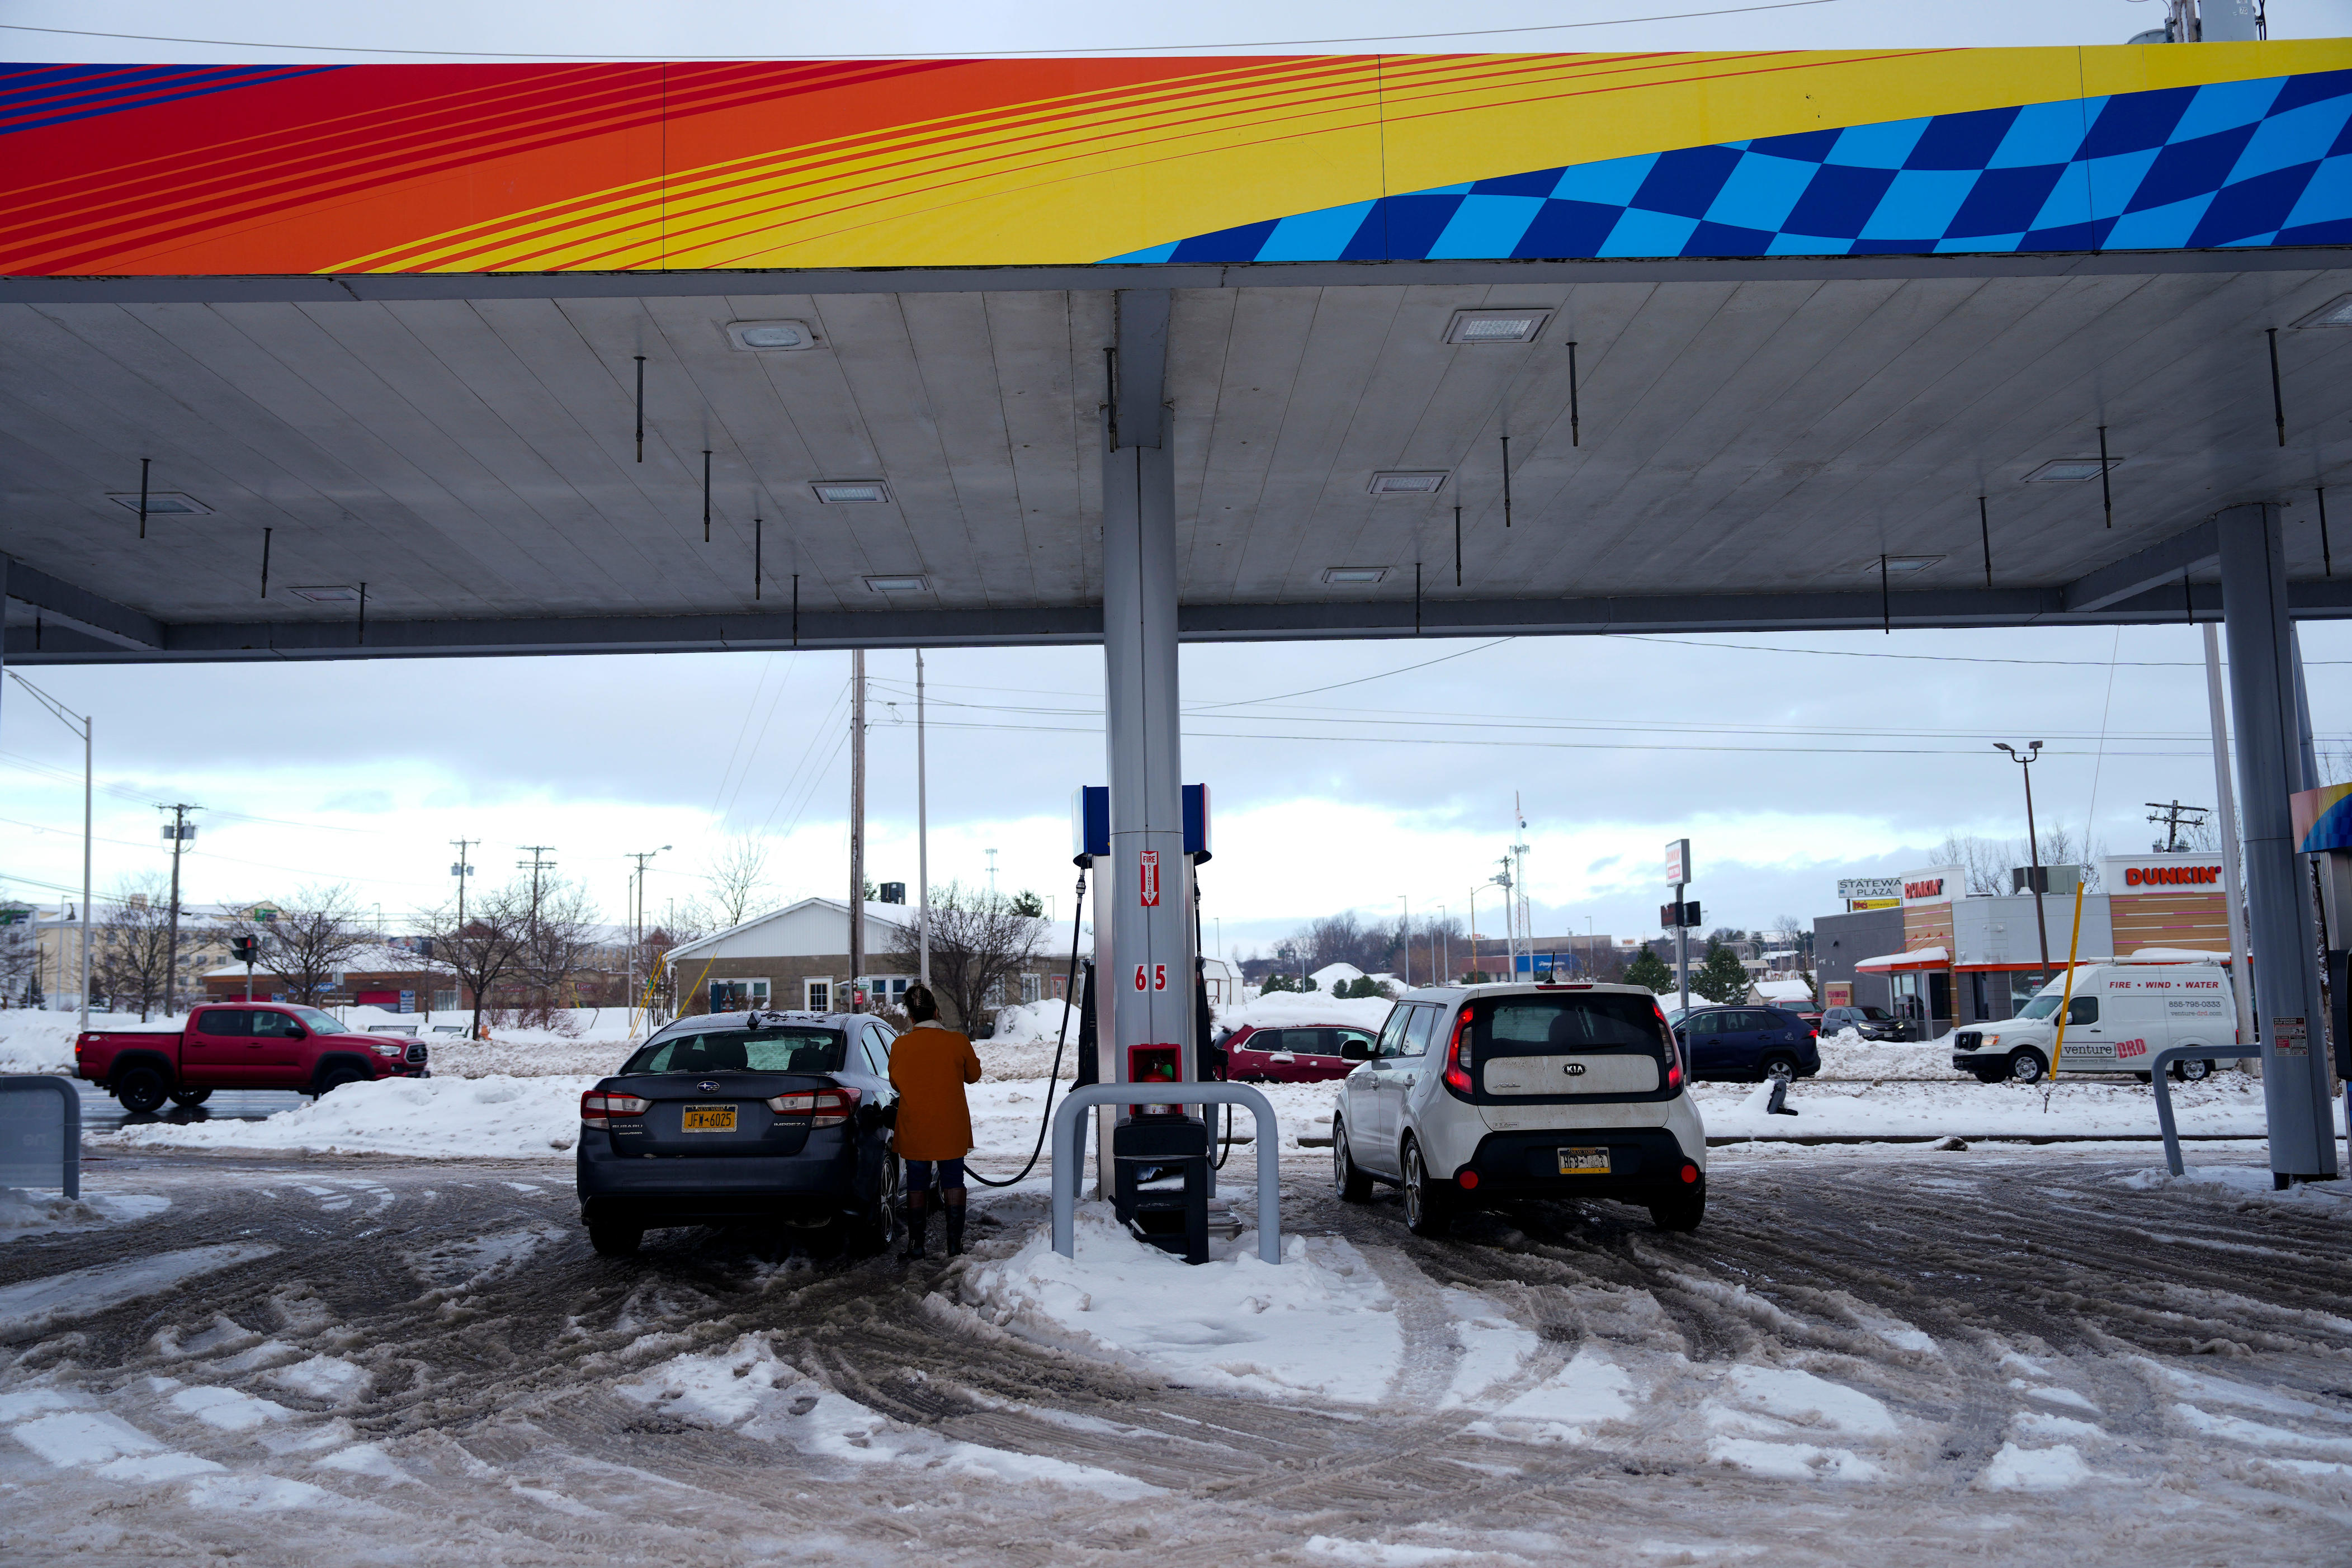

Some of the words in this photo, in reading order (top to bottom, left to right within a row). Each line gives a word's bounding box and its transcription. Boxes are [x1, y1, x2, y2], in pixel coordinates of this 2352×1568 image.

[2126, 866, 2222, 886] DUNKIN'
[1904, 879, 1943, 899] DUNKIN'
[2063, 1045, 2112, 1054] venture
[2116, 1038, 2147, 1059] DRD
